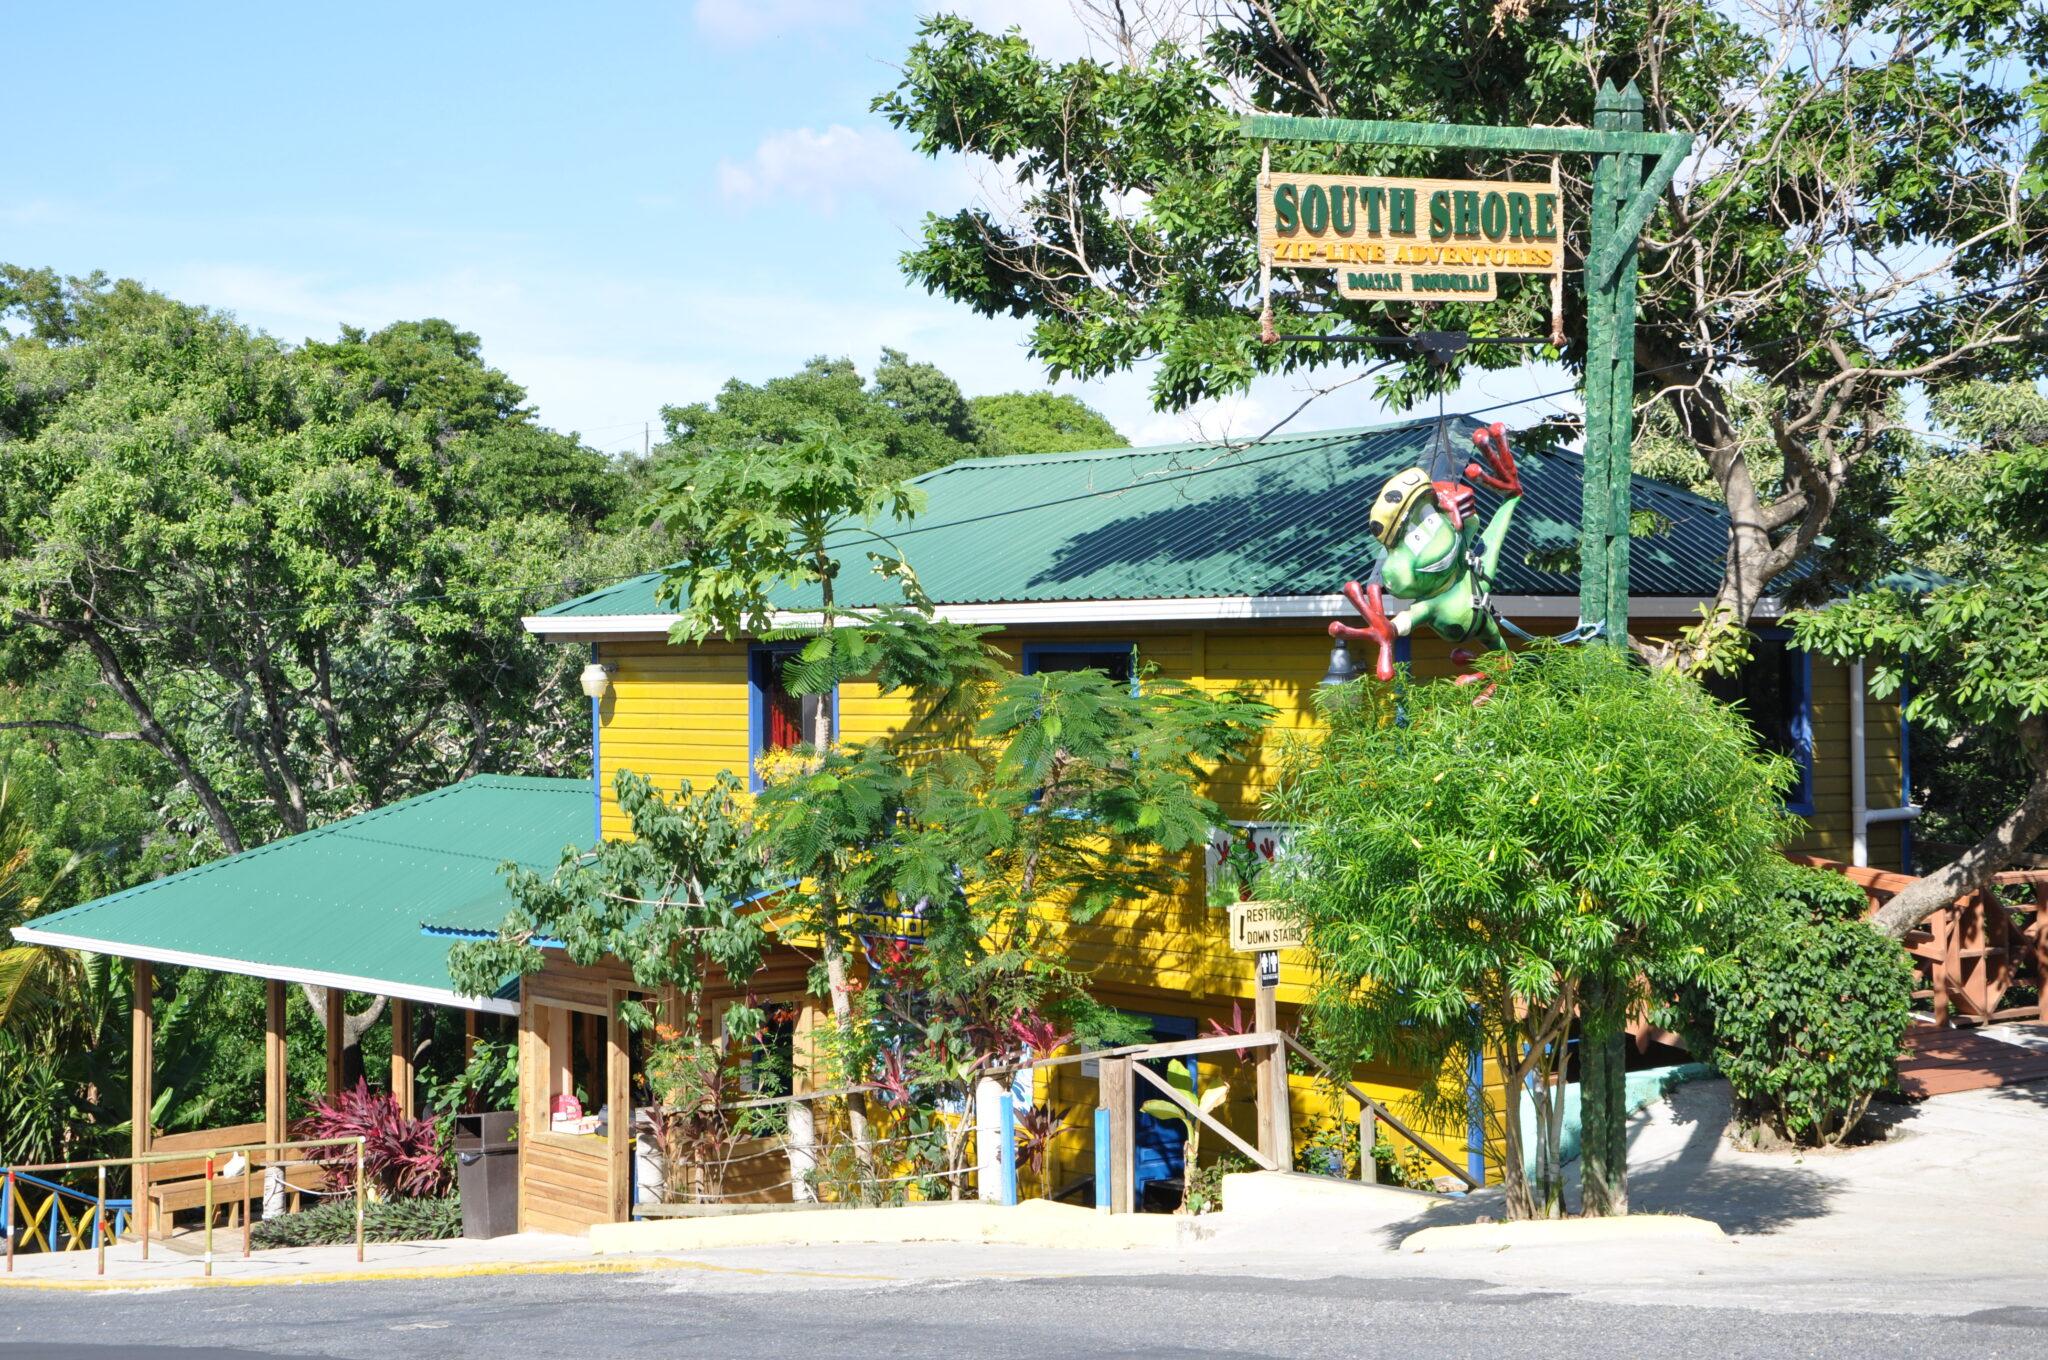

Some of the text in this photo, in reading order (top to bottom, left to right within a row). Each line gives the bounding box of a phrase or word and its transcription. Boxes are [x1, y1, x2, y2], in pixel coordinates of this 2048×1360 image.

[1273, 183, 1557, 239] SOUTH SHORE
[1274, 241, 1553, 267] ZIP-LINE ADVENTURES
[1347, 272, 1490, 292] ROATAN HONDURAS
[1247, 928, 1302, 944] DOWN STAIRS
